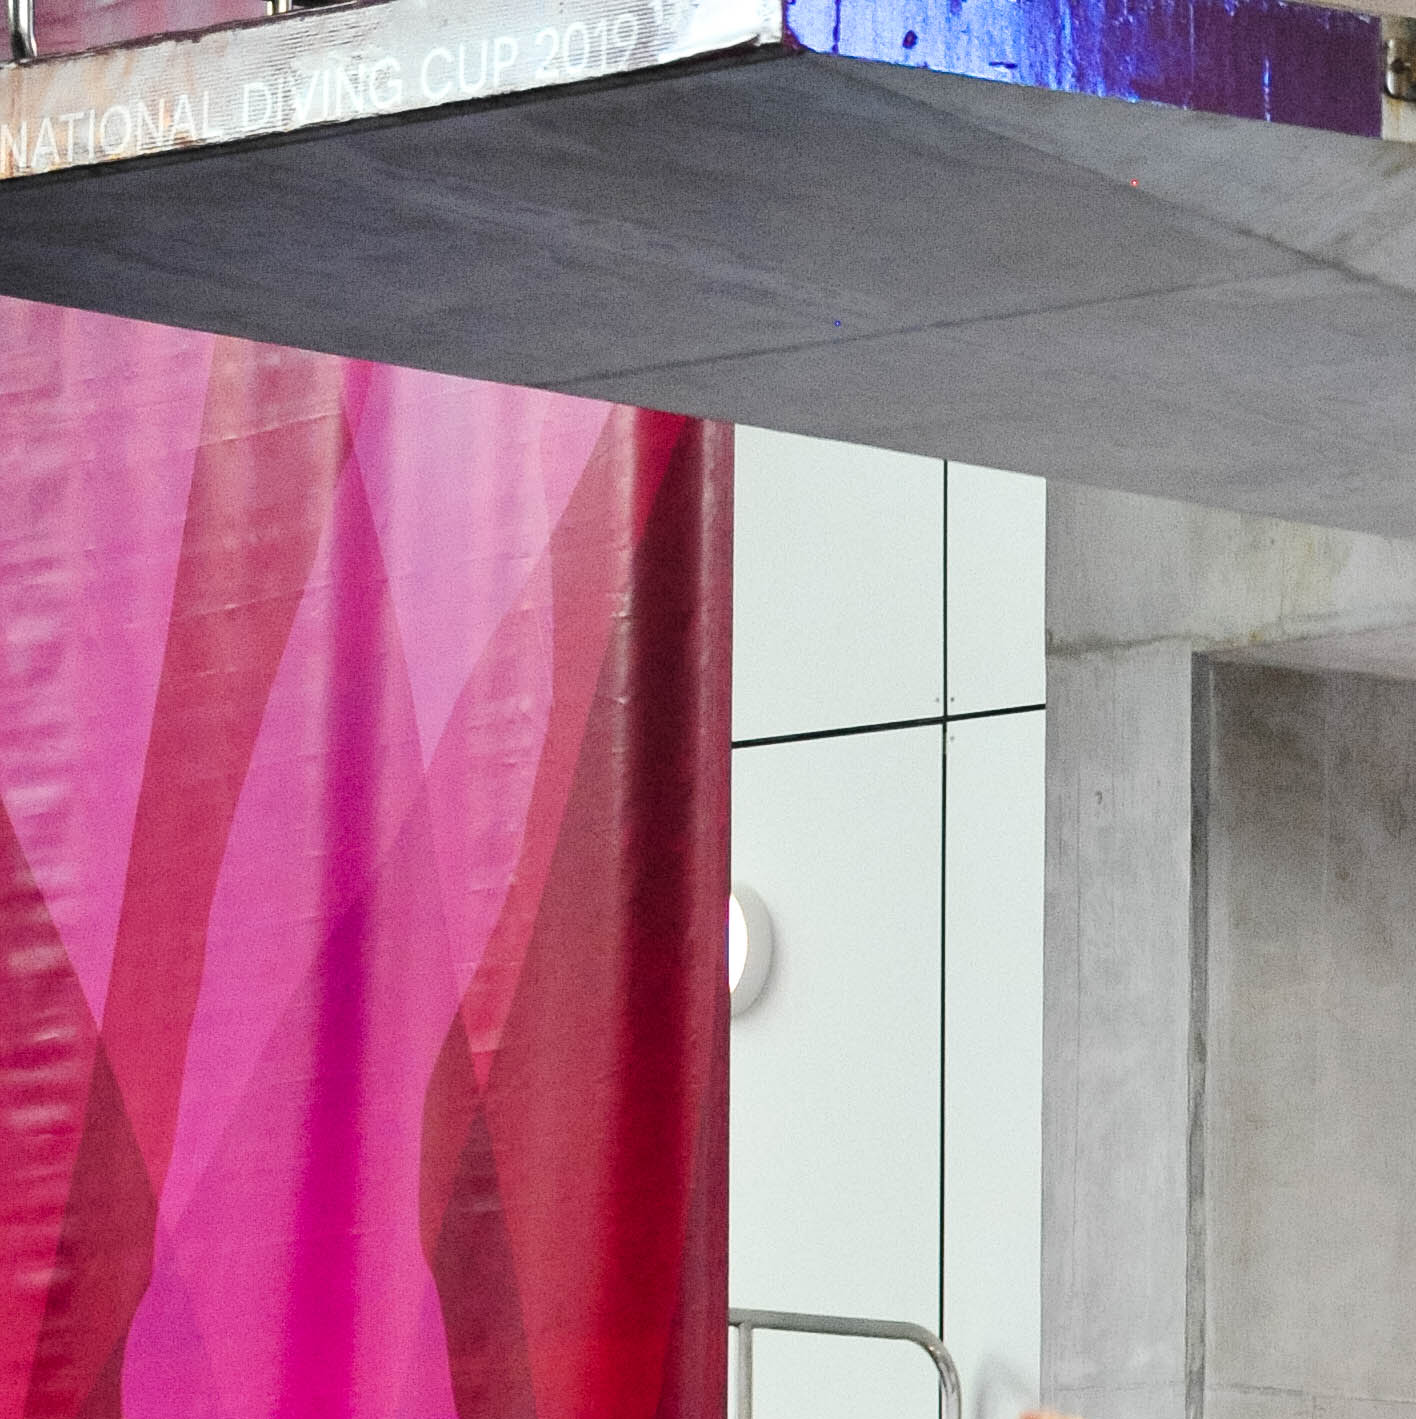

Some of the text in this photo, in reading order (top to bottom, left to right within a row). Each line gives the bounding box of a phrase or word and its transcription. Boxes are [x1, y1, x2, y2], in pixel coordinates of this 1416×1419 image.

[0, 14, 638, 171] NATIONAL DIVING CUP 2019
